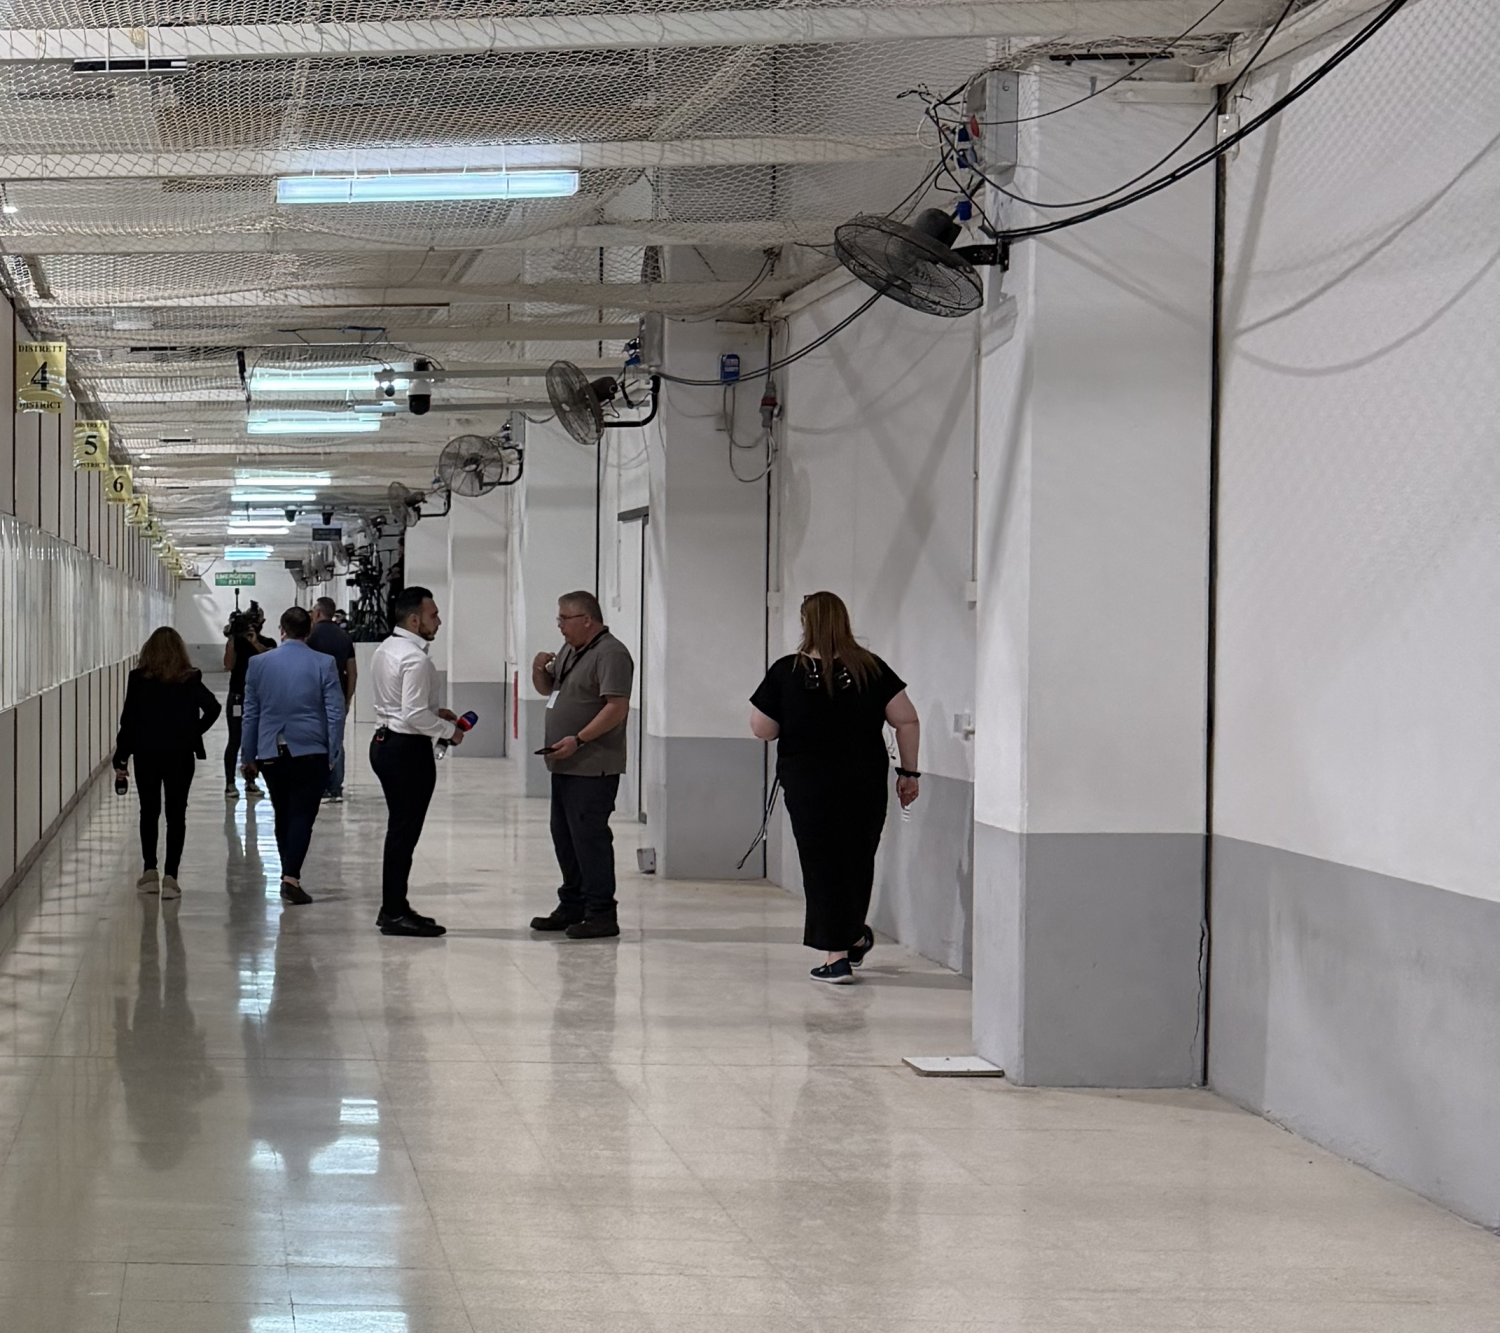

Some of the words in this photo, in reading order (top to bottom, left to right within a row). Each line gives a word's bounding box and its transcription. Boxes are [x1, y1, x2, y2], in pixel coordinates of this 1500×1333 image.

[30, 361, 50, 391] 4
[84, 434, 98, 456] 5
[112, 475, 125, 493] 6
